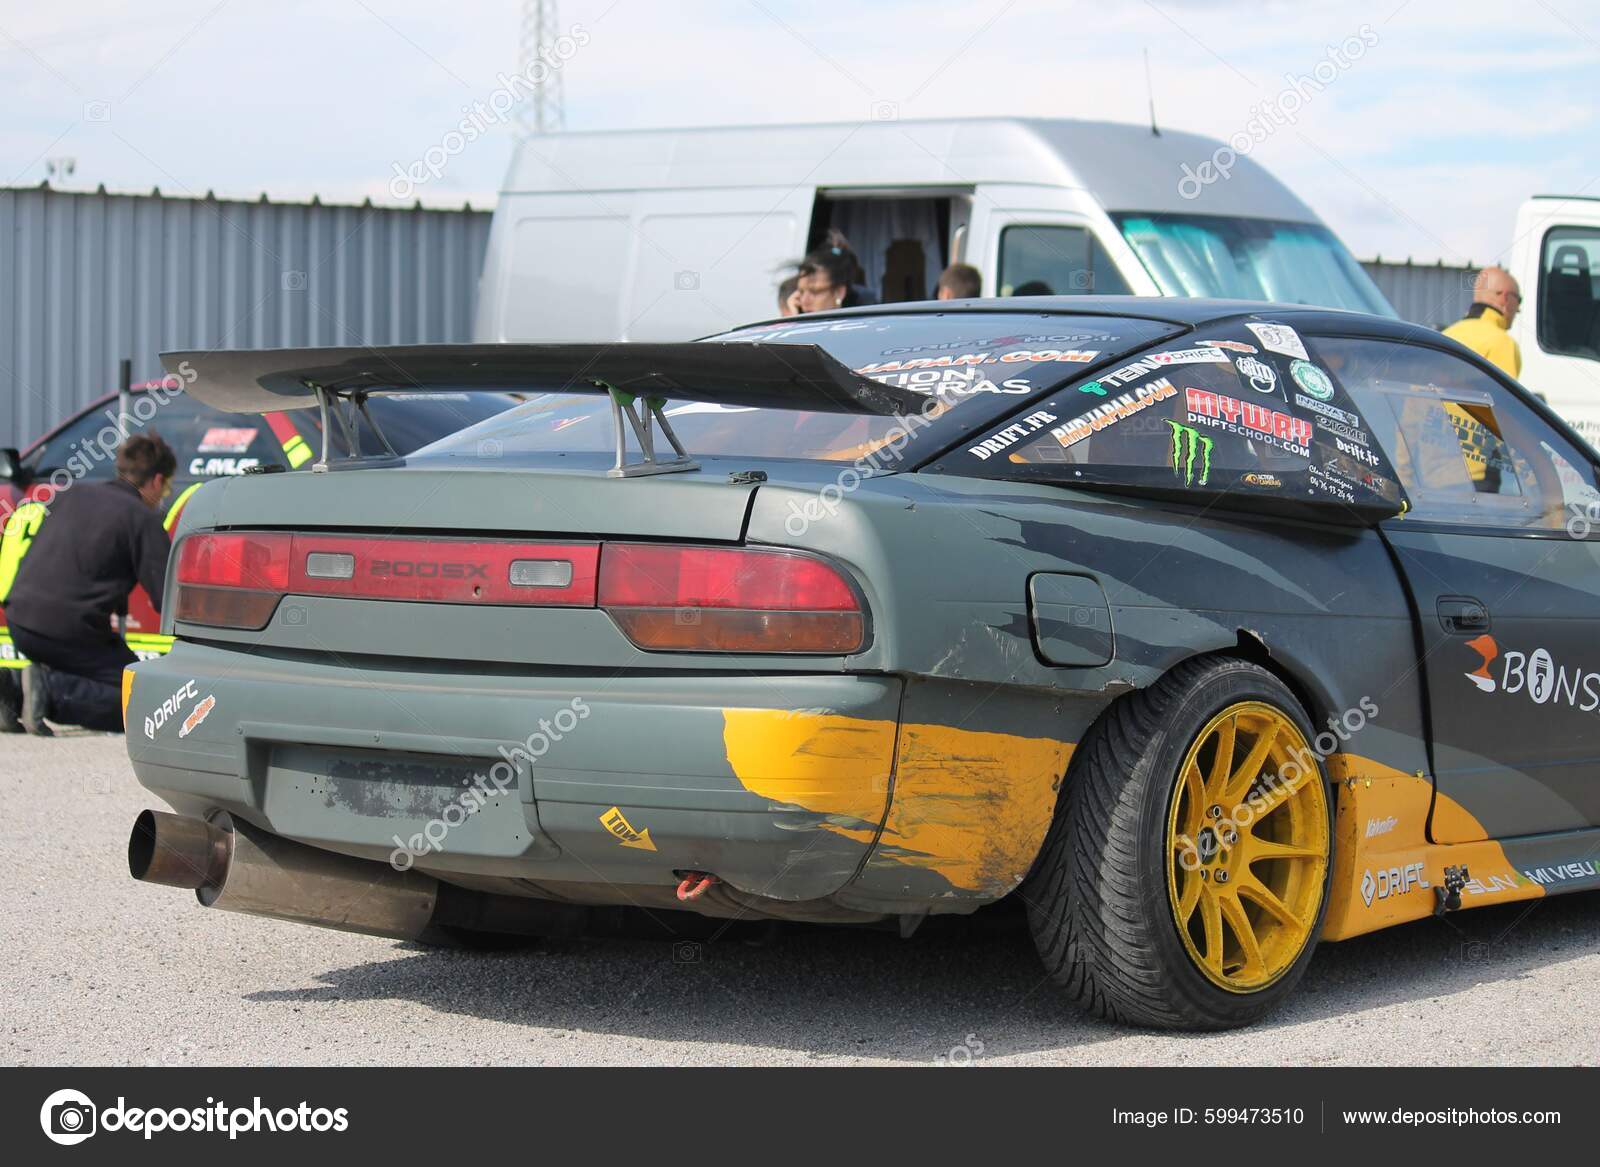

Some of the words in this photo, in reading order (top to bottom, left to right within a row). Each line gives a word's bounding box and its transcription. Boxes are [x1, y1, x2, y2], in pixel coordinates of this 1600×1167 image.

[868, 367, 977, 385] TION
[1096, 354, 1163, 388] TEIN
[897, 379, 1032, 396] ERAS
[1185, 387, 1313, 447] MYWAY
[1187, 412, 1310, 458] DRIFTSCHOOL.COM
[368, 559, 492, 580] 200SX
[606, 812, 643, 842] TOW
[1548, 860, 1600, 880] VISU
